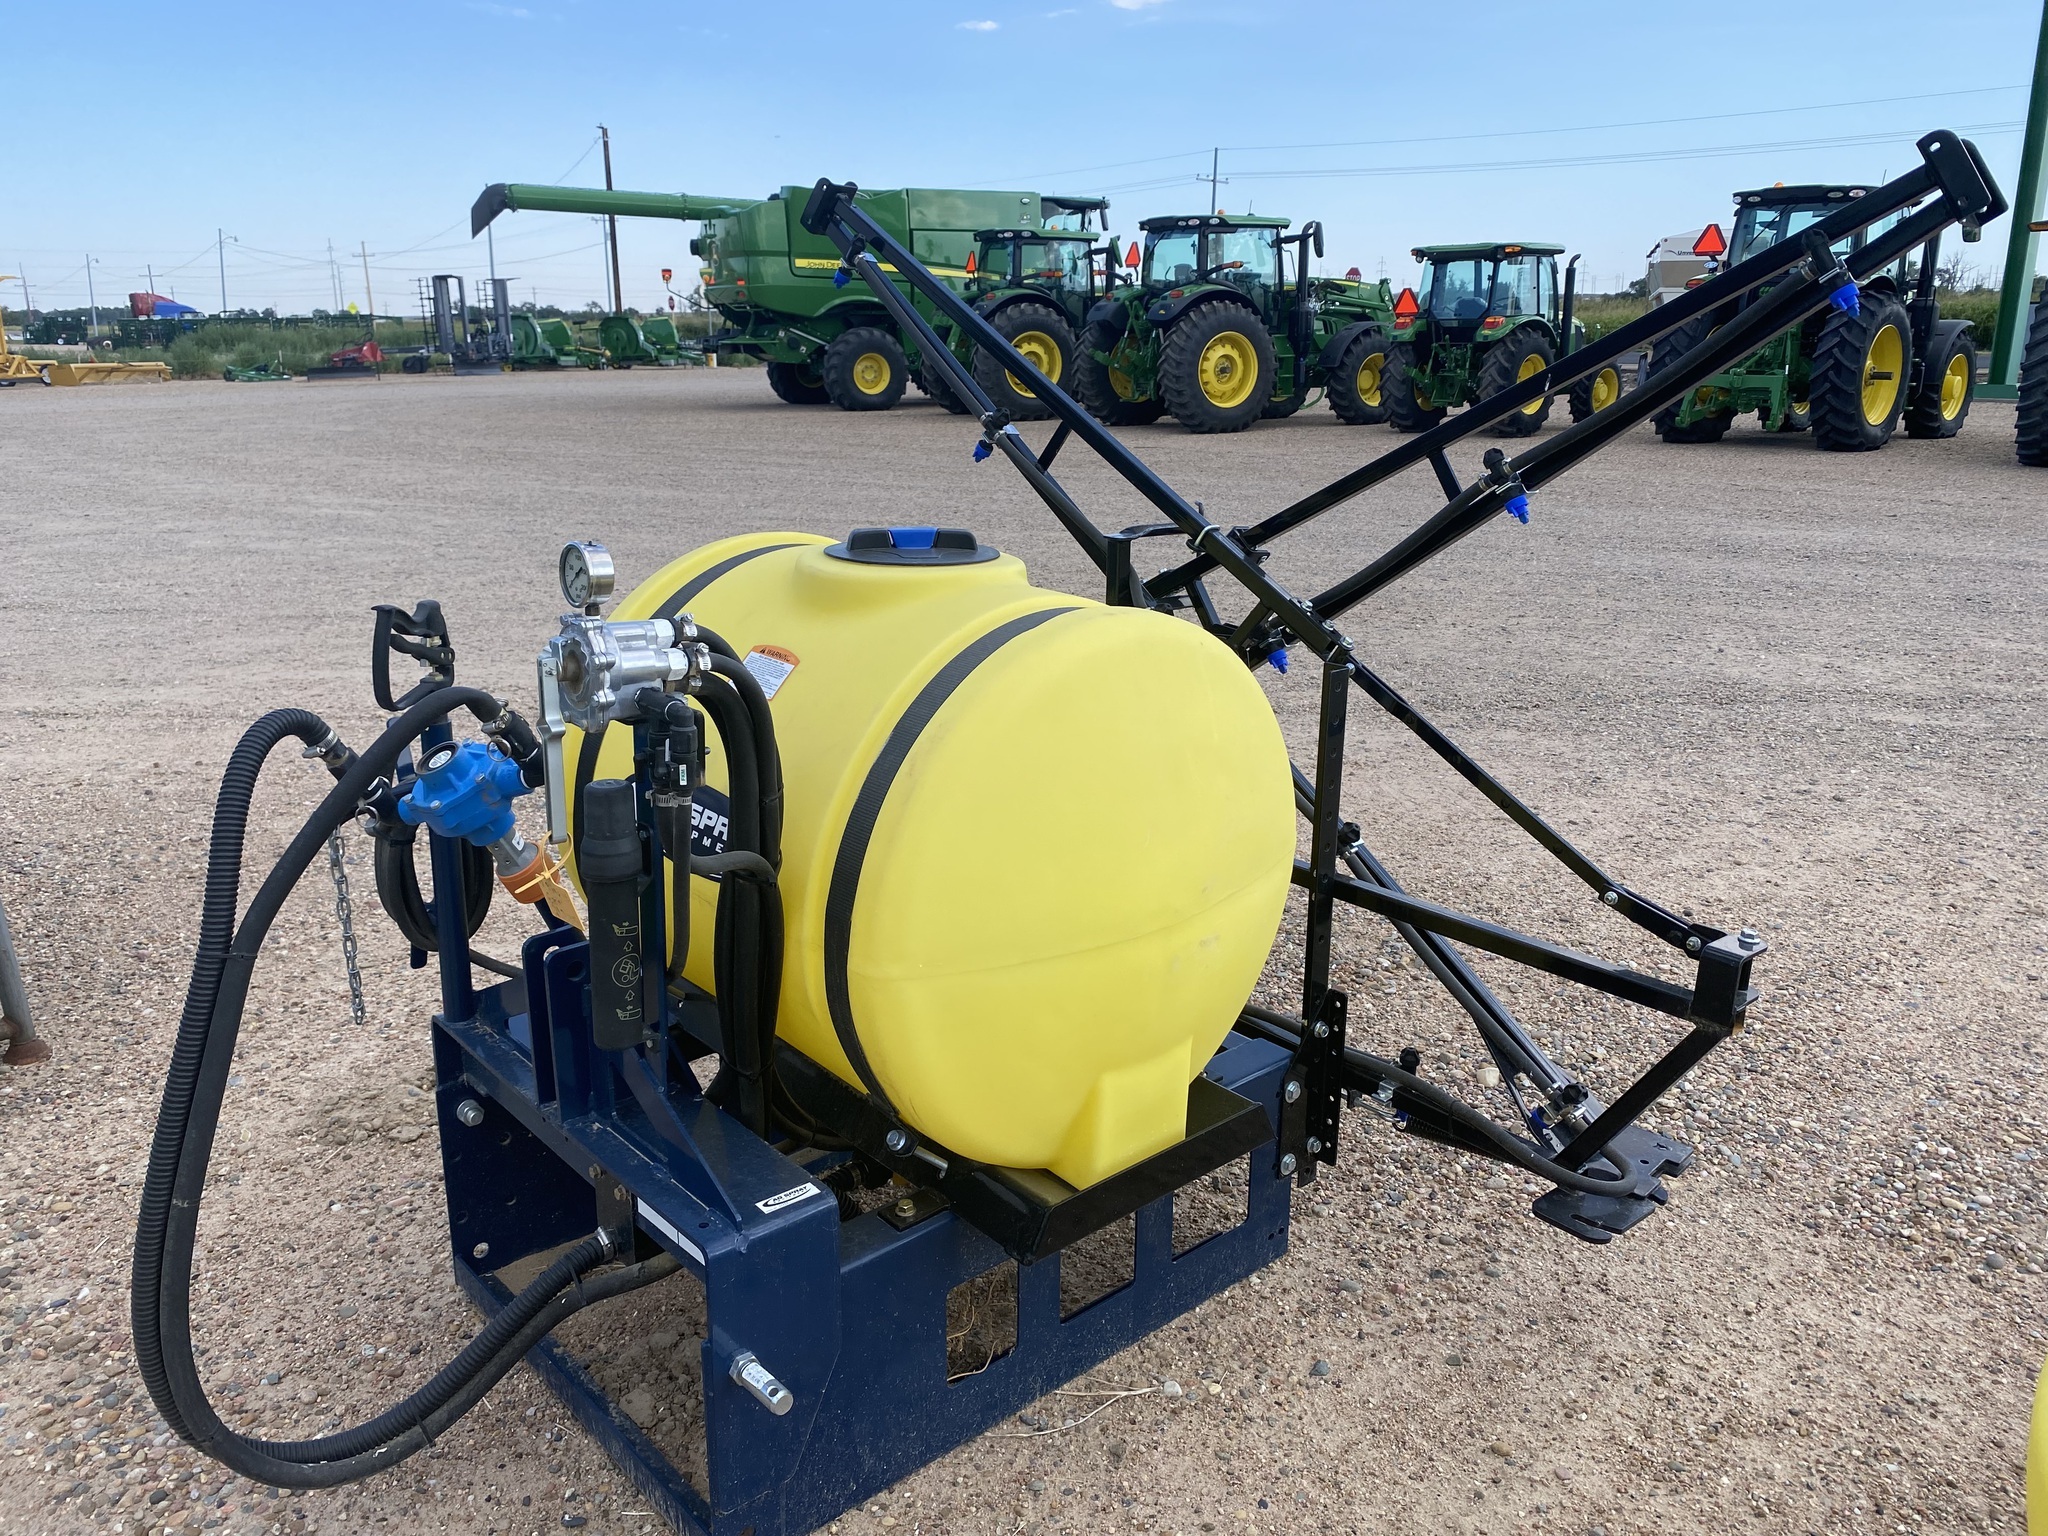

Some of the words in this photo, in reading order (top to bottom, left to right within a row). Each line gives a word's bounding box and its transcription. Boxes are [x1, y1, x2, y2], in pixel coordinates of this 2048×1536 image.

[807, 260, 826, 268] JOHN
[691, 802, 729, 841] SPRA
[783, 1185, 807, 1198] SPRAY
